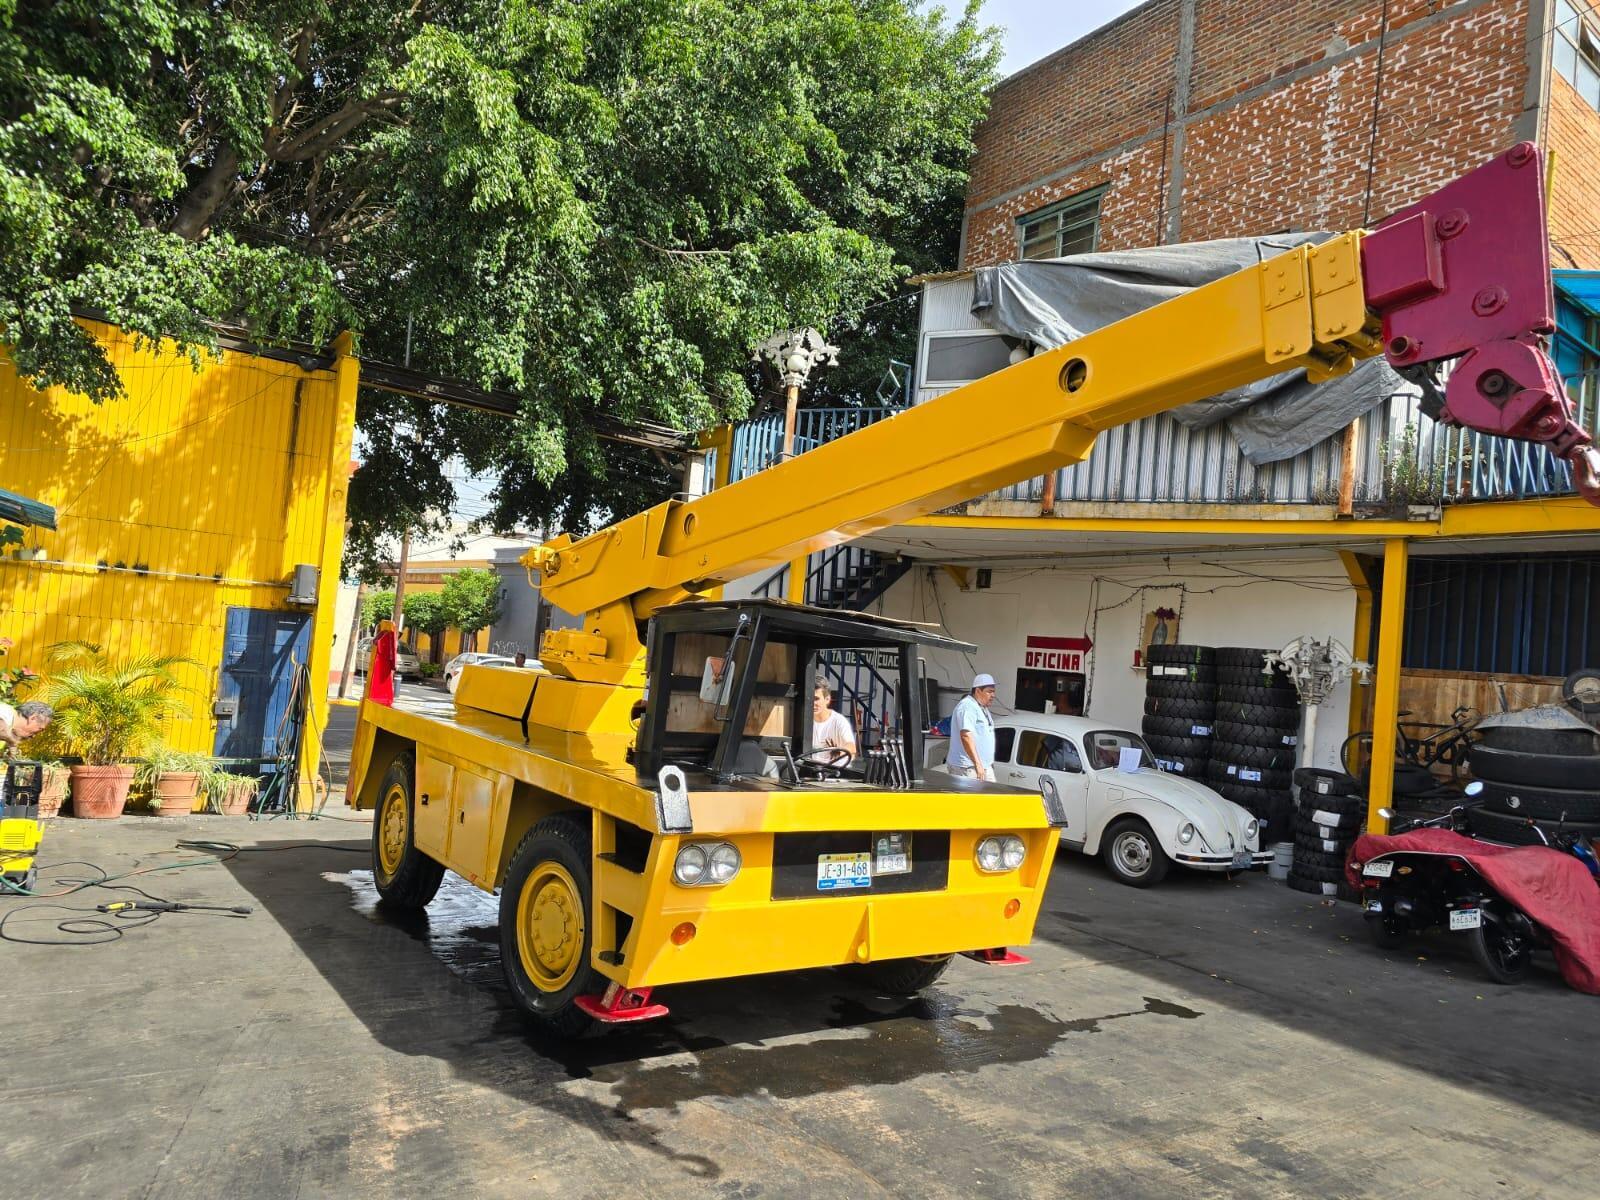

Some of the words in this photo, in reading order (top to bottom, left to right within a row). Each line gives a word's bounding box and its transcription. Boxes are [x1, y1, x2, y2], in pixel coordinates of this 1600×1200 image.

[845, 651, 857, 664] DE
[1026, 652, 1080, 670] OFICINA
[821, 862, 868, 879] JE-31-468
